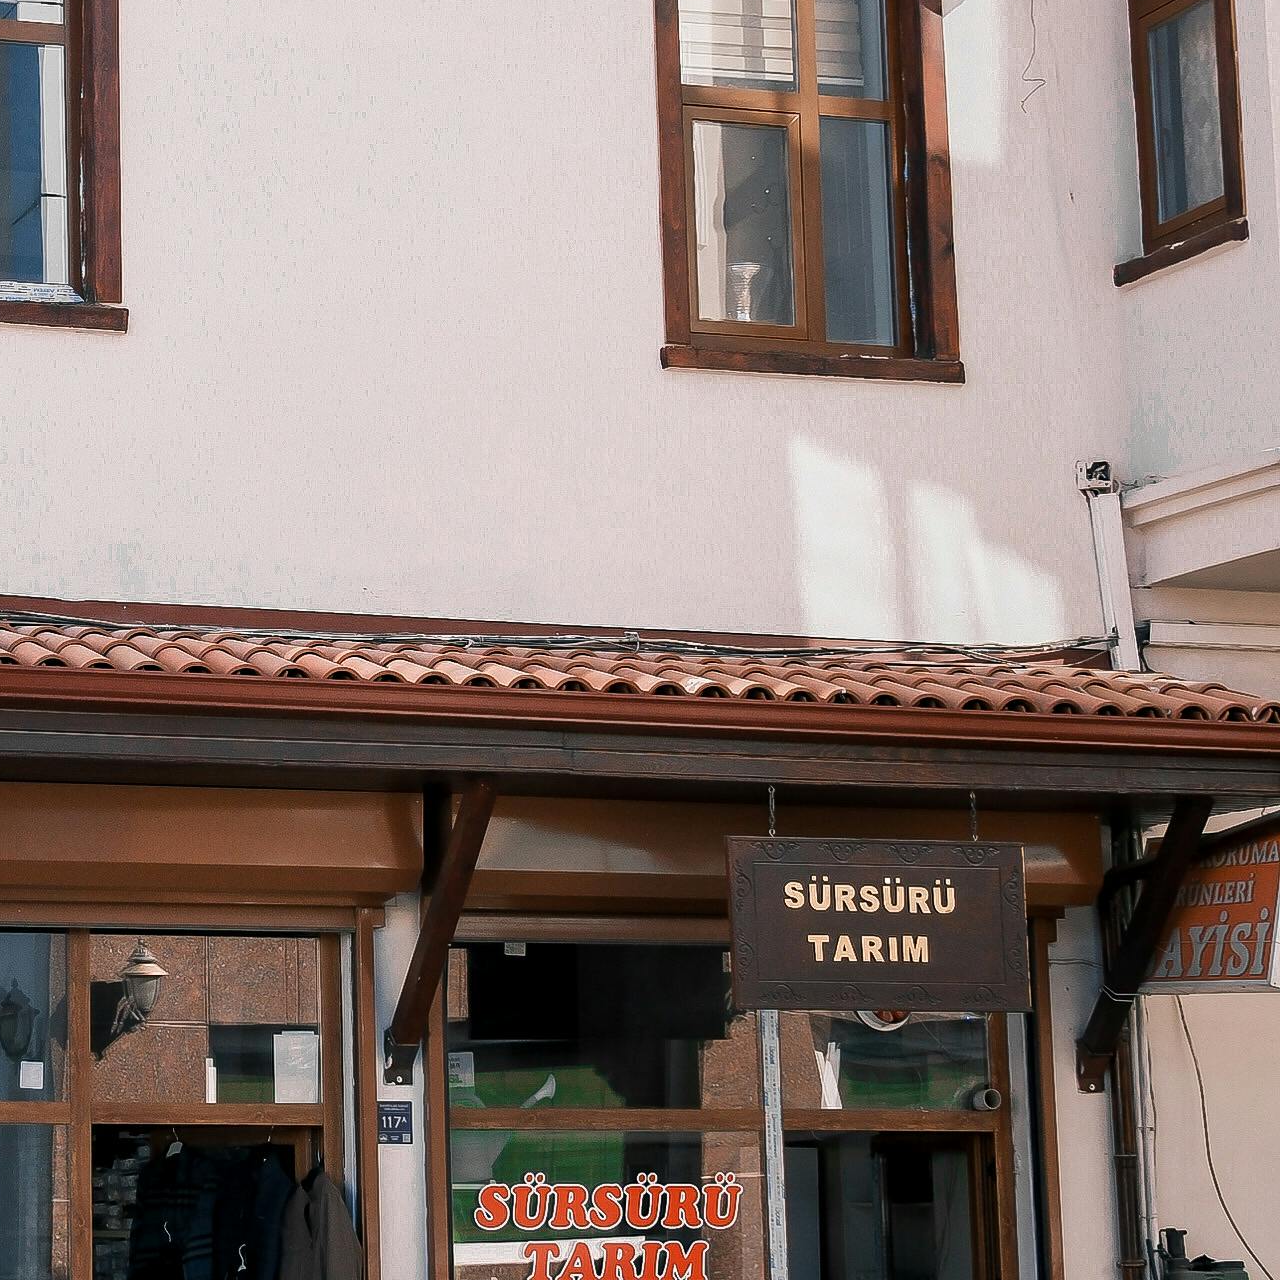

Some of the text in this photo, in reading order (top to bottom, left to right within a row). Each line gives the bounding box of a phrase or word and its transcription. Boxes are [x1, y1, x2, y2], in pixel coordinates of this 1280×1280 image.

[783, 875, 956, 914] SÜRSÜRÜ
[1174, 872, 1256, 907] RÜNLERİ
[807, 934, 929, 963] TARIM
[1146, 907, 1271, 978] AYİSİ
[473, 1171, 744, 1231] SÜRSÜRÜ
